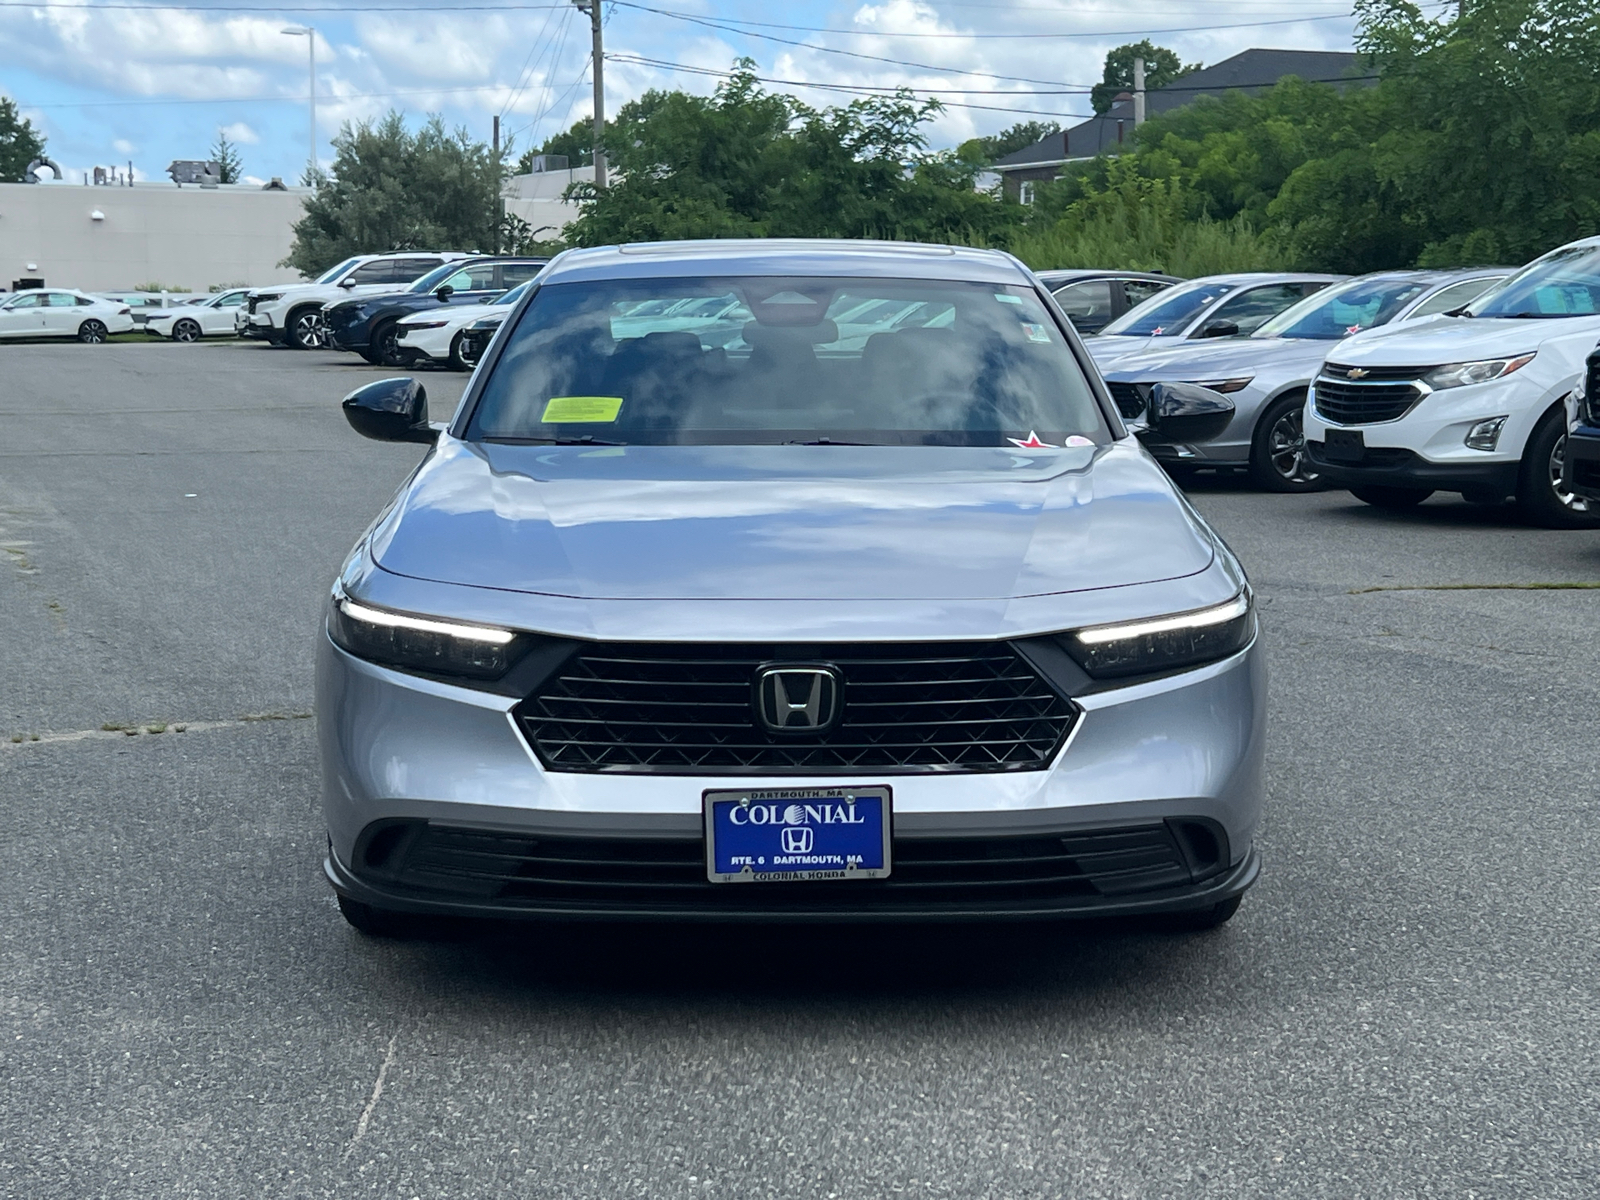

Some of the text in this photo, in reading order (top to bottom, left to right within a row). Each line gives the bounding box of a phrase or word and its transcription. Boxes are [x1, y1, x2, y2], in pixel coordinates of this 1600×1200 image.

[730, 804, 865, 825] COLONIAL
[731, 855, 863, 865] RTE. 6 DARTMOUTH, MA
[753, 871, 846, 881] COLONIAL HONDA
